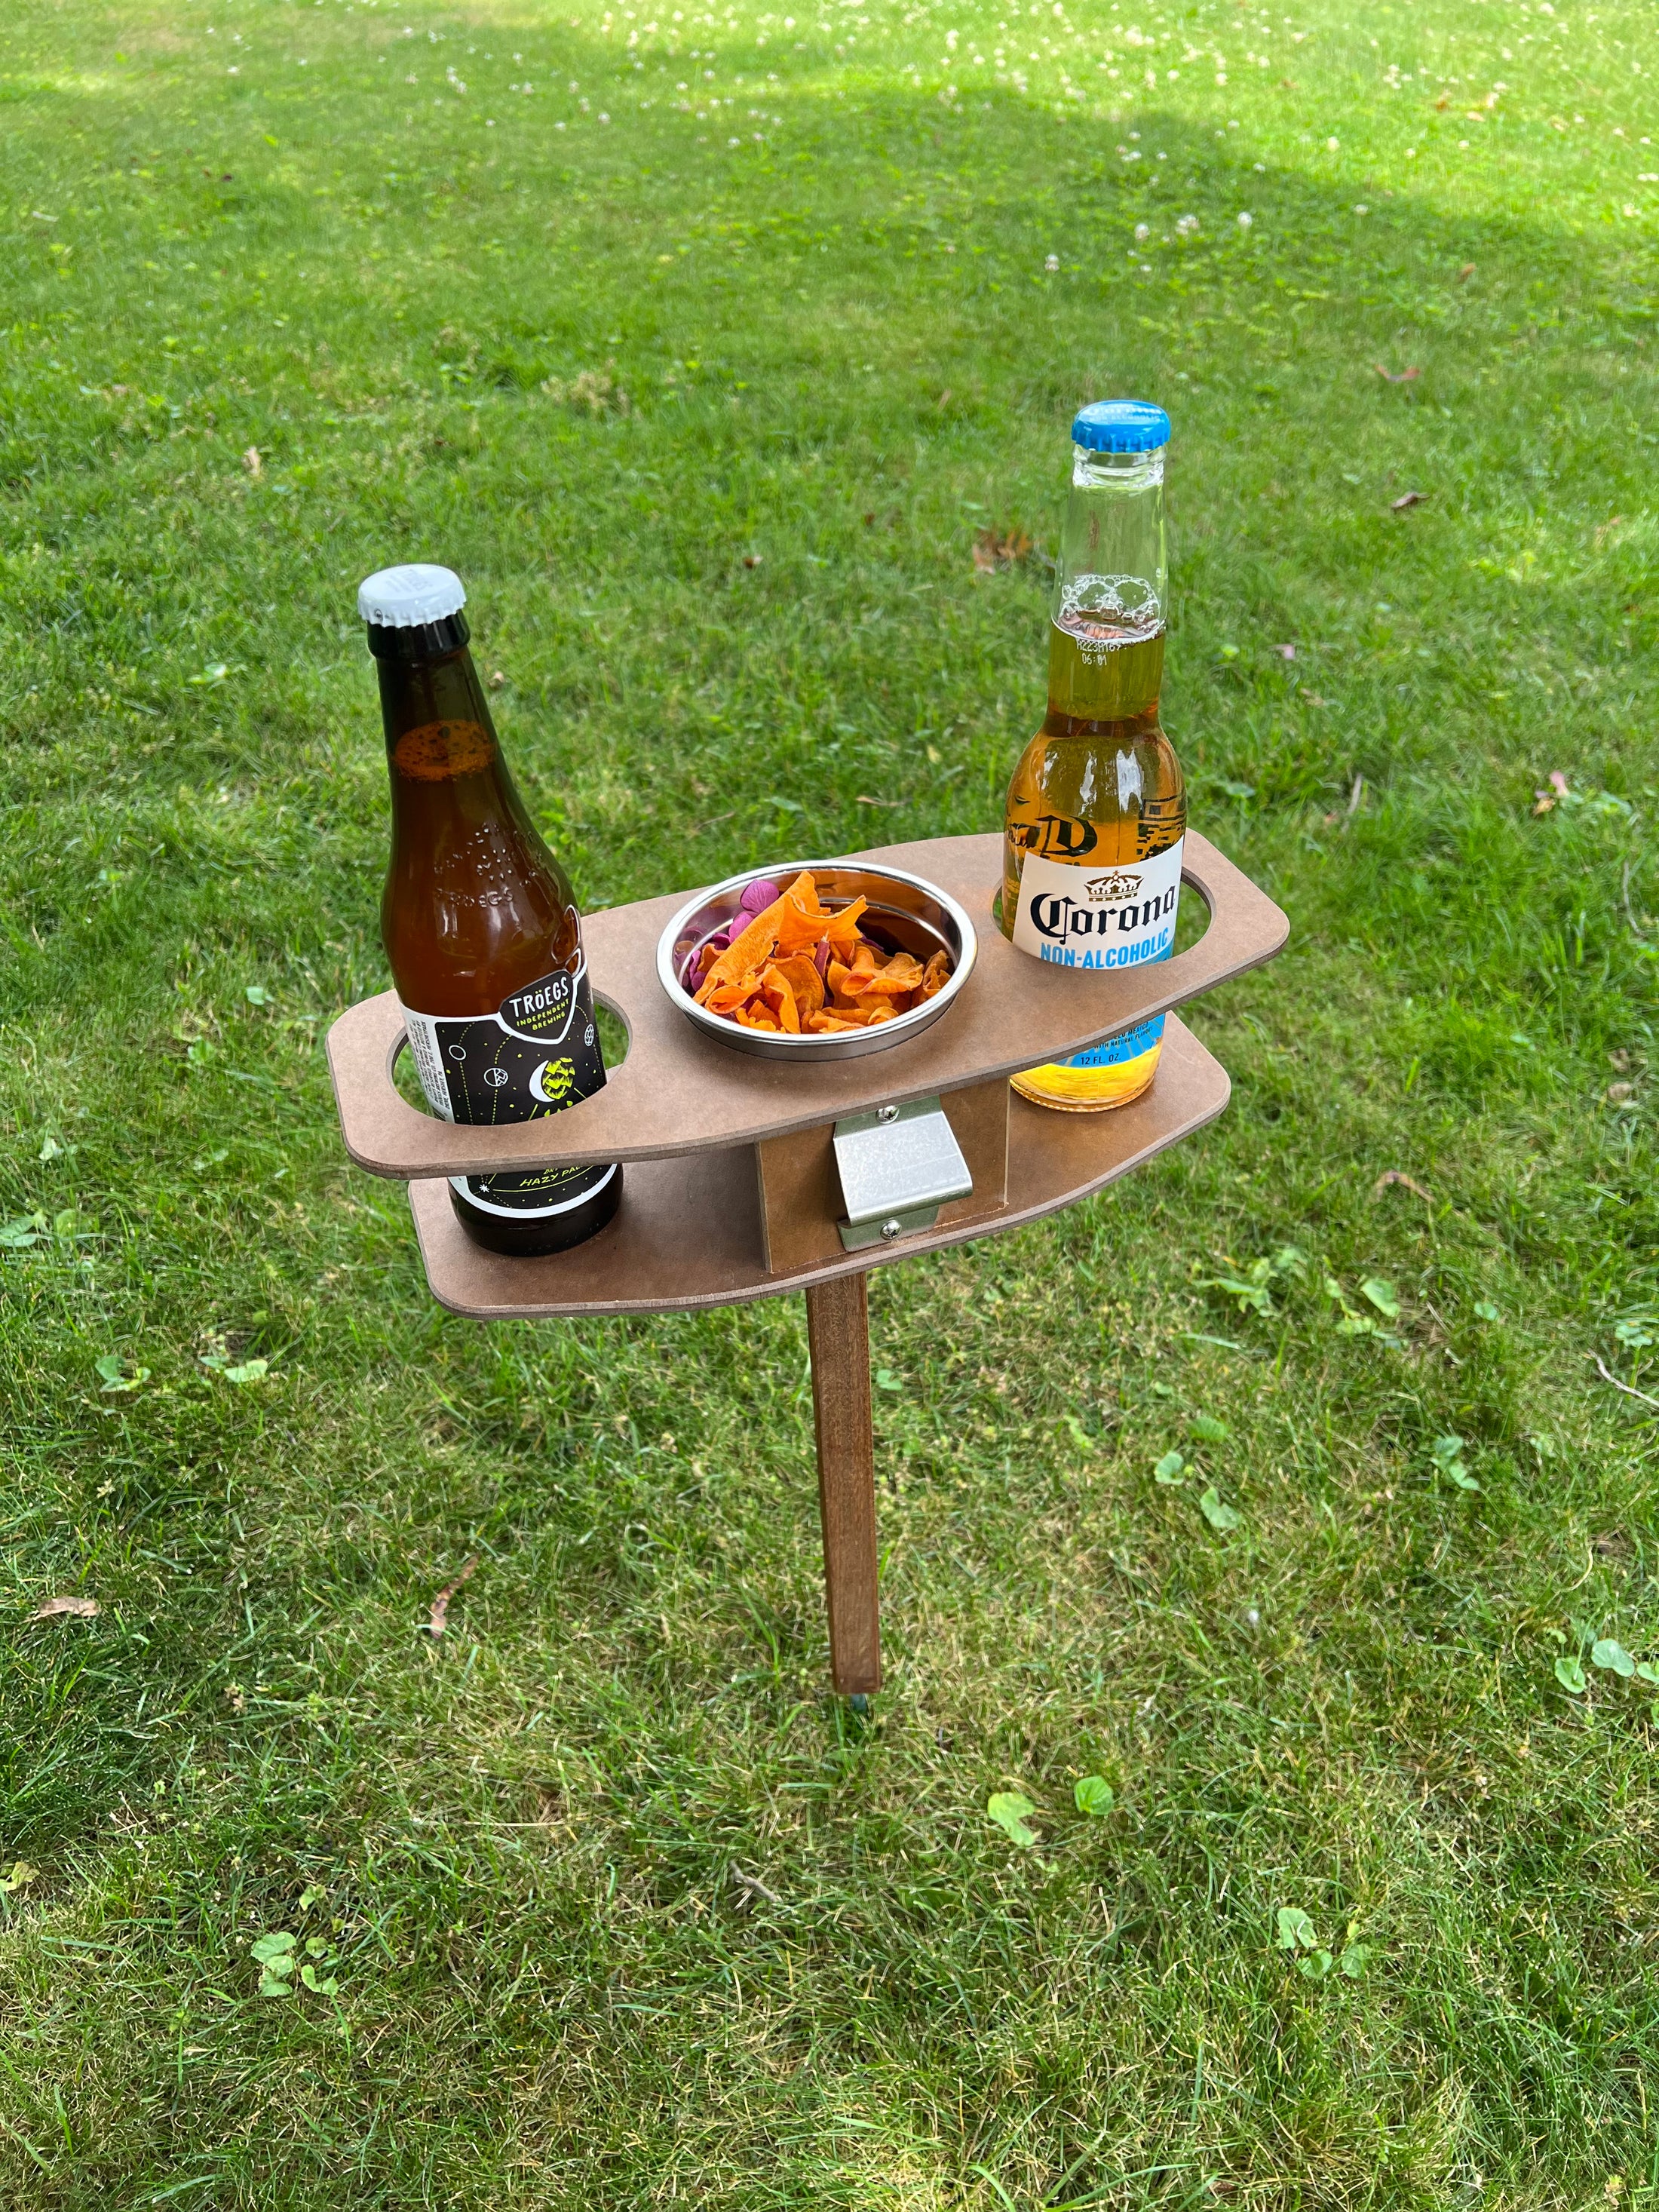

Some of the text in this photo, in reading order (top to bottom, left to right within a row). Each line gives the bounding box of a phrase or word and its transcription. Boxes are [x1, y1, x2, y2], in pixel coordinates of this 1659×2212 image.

[1030, 885, 1176, 945] Corona
[1041, 927, 1169, 969] NON-ALCOHOLIC
[509, 976, 569, 1017] TRÖEGS
[516, 998, 569, 1027] INDEPENDENT
[532, 1011, 566, 1031] BREWING
[1111, 1038, 1133, 1048] NATURAL
[1081, 1053, 1121, 1065] 12 FL. OZ.
[519, 1165, 583, 1186] HAZY PAL
